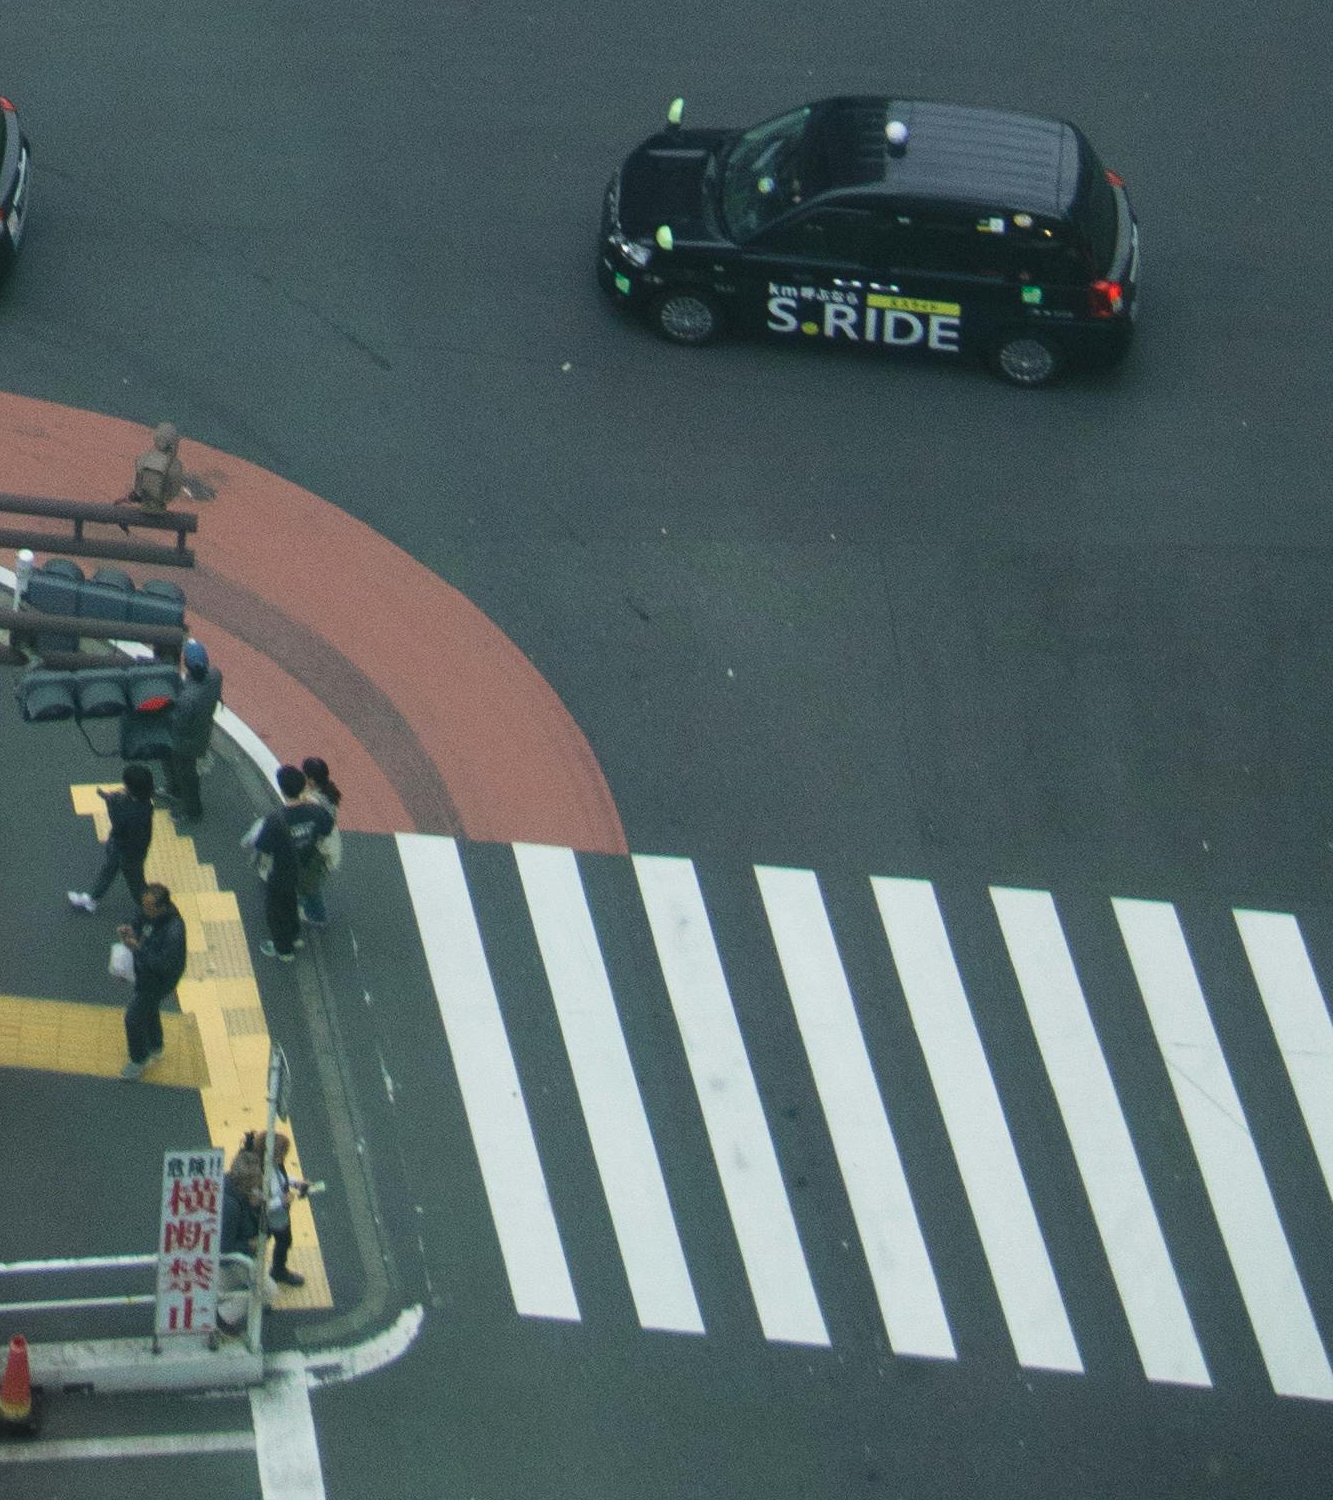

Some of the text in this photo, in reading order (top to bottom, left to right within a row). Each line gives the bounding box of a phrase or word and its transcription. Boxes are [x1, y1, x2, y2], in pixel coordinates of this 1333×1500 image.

[766, 295, 962, 352] S.RIDE
[164, 1178, 218, 1332] 横断禁止
